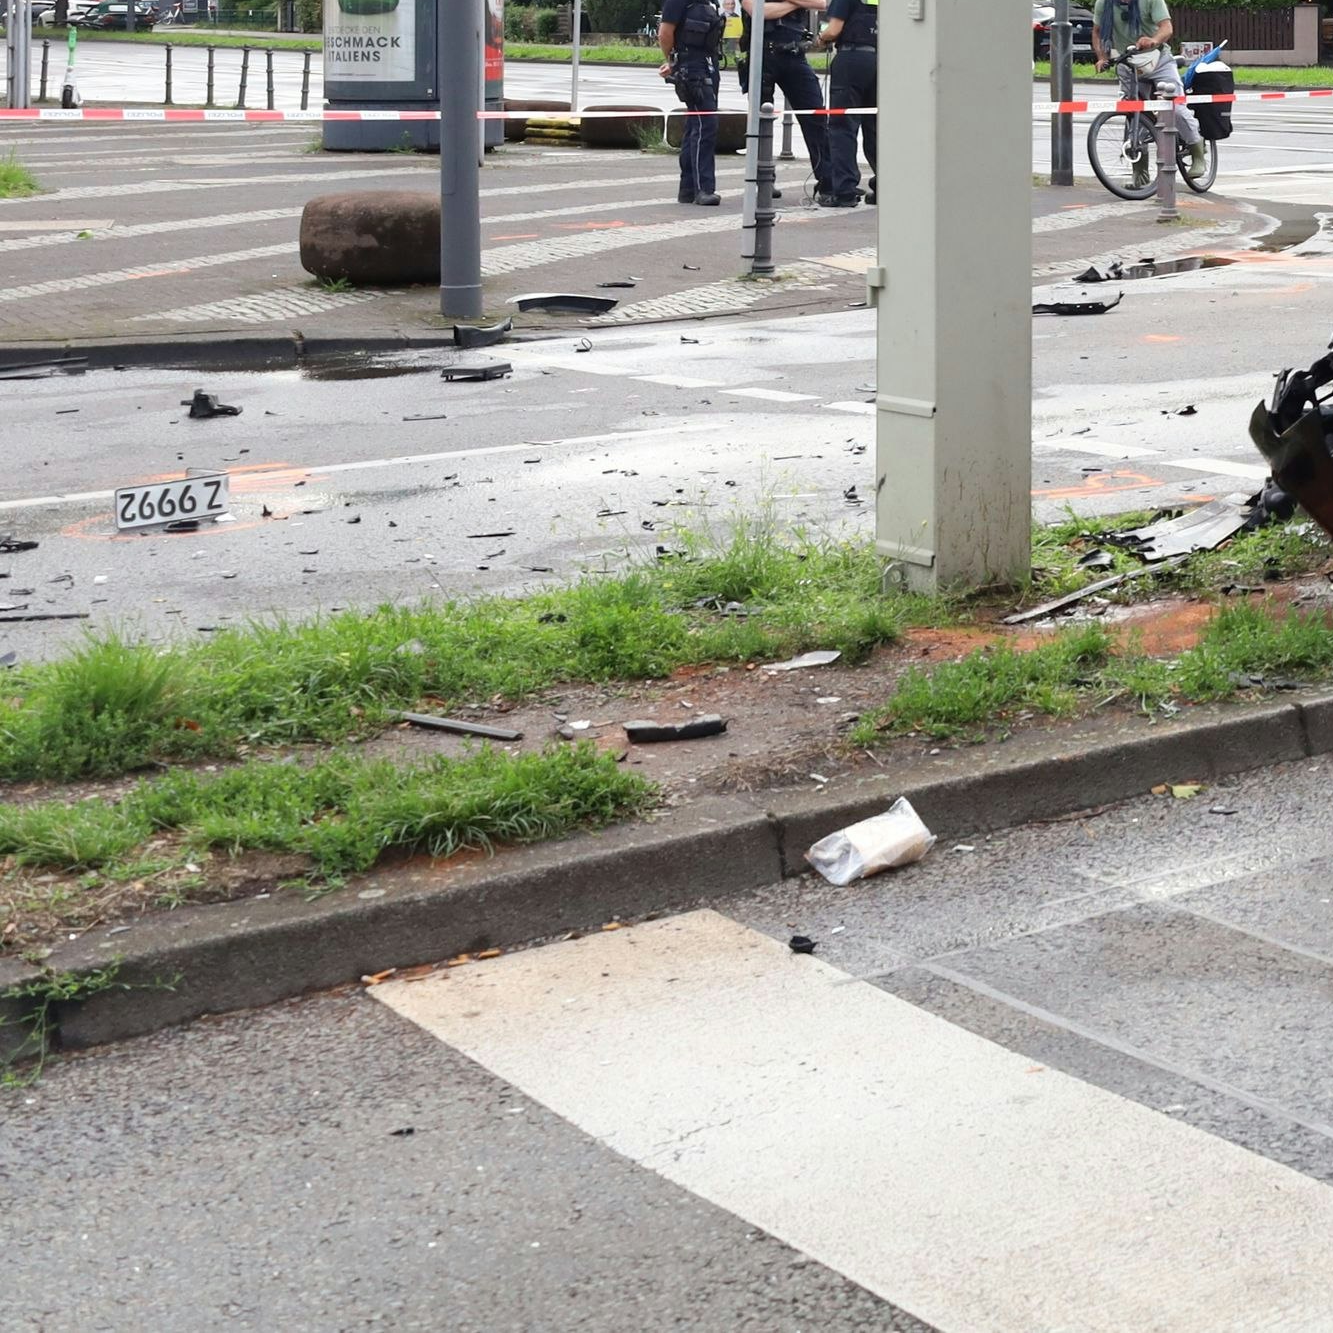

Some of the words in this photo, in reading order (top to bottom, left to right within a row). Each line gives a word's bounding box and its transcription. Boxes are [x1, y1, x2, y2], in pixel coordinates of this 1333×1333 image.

[362, 26, 381, 34] DEN
[328, 50, 381, 62] ITALIENS
[119, 484, 197, 523] 9992
[203, 480, 223, 510] Z
